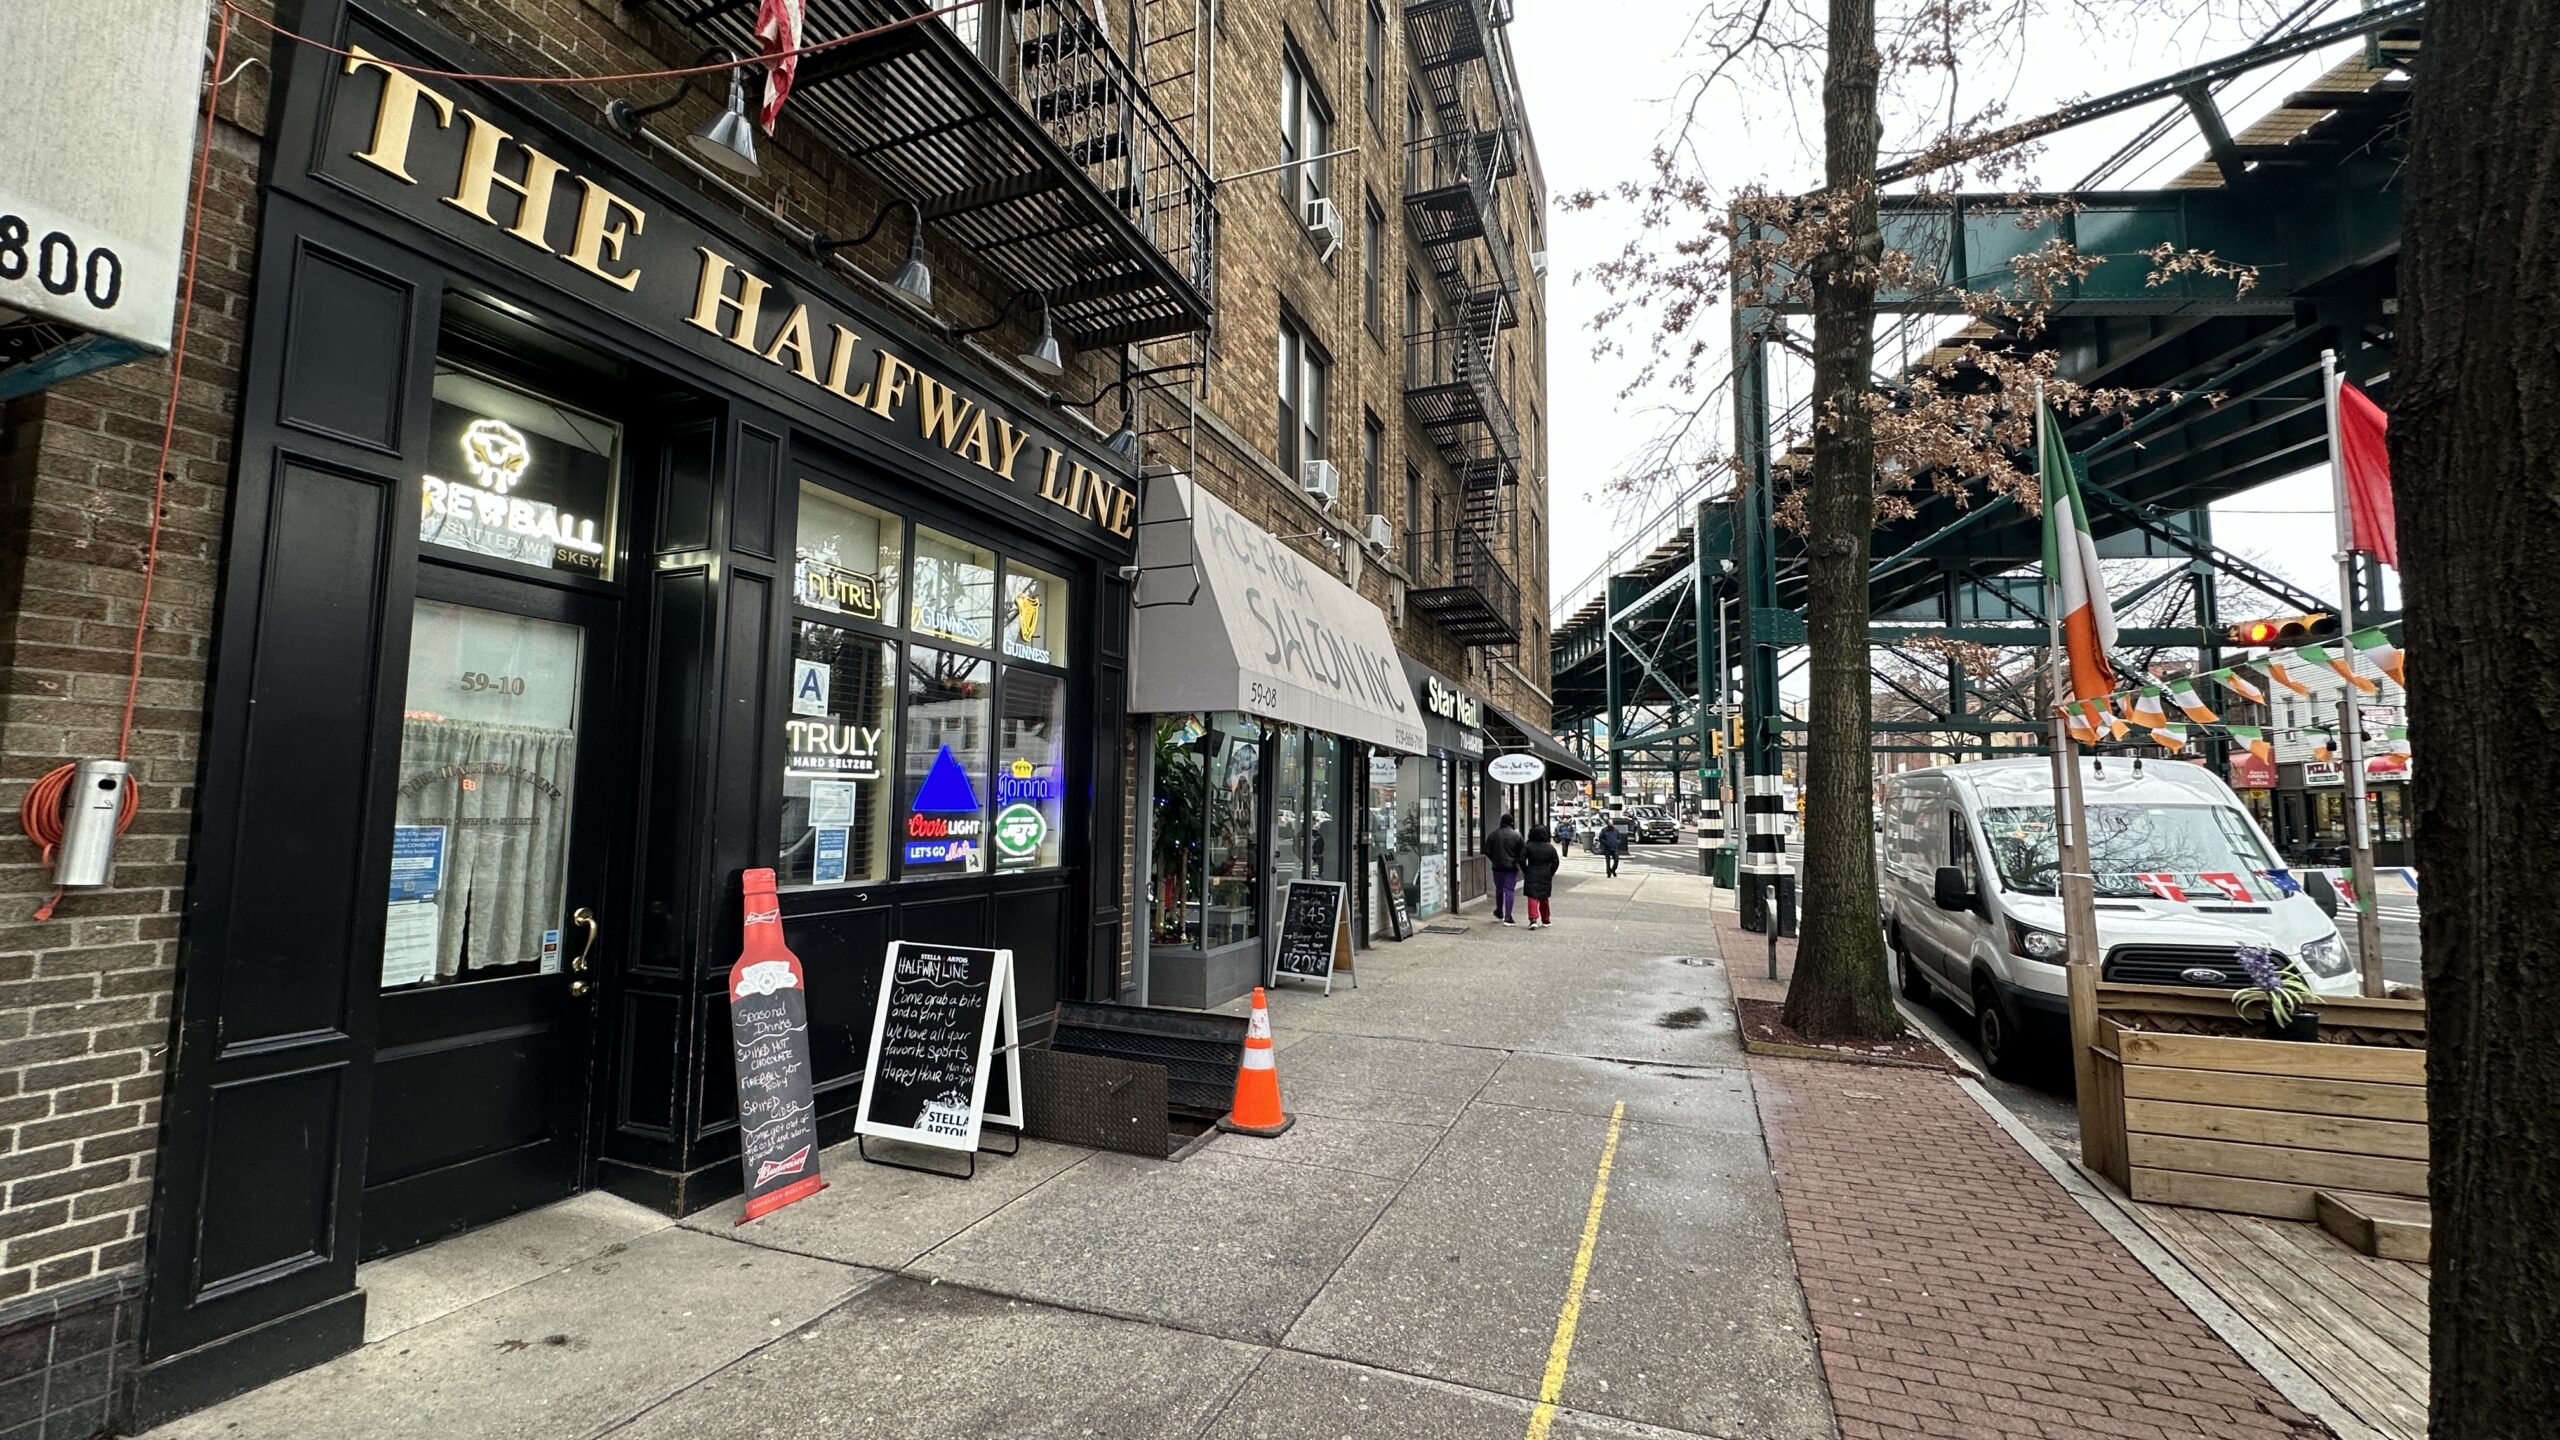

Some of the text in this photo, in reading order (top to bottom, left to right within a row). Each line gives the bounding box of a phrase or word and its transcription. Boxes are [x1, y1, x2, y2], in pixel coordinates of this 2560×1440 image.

[345, 45, 1137, 539] THE HALFWAY LINE
[920, 605, 980, 640] GUINNESS
[1002, 639, 1050, 664] GUINNESS
[1246, 587, 1405, 714] SALON INC
[460, 671, 525, 697] 59-10
[799, 668, 822, 701] A
[1250, 682, 1277, 709] 59-08
[1428, 675, 1477, 729] Star Nail
[793, 757, 873, 770] HARD SELTZER
[998, 772, 1048, 806] Corona
[908, 813, 981, 837] Coors LIGHT
[910, 846, 932, 859] LET'S
[932, 845, 945, 857] GO
[897, 956, 969, 982] HALFWAY LINE
[920, 953, 968, 963] STELLA ARTOIS
[891, 1005, 909, 1018] and
[910, 1009, 918, 1019] a
[892, 986, 983, 1014] Come grab a bite
[735, 1001, 786, 1026] Seasonal
[754, 1018, 792, 1036] Drinks
[886, 1023, 972, 1050] We have all your
[772, 1037, 790, 1053] HOT
[884, 1038, 925, 1058] favorite
[881, 1058, 918, 1086] Happy
[928, 1112, 969, 1126] STELLA
[745, 1131, 769, 1148] Come
[770, 1123, 784, 1137] get
